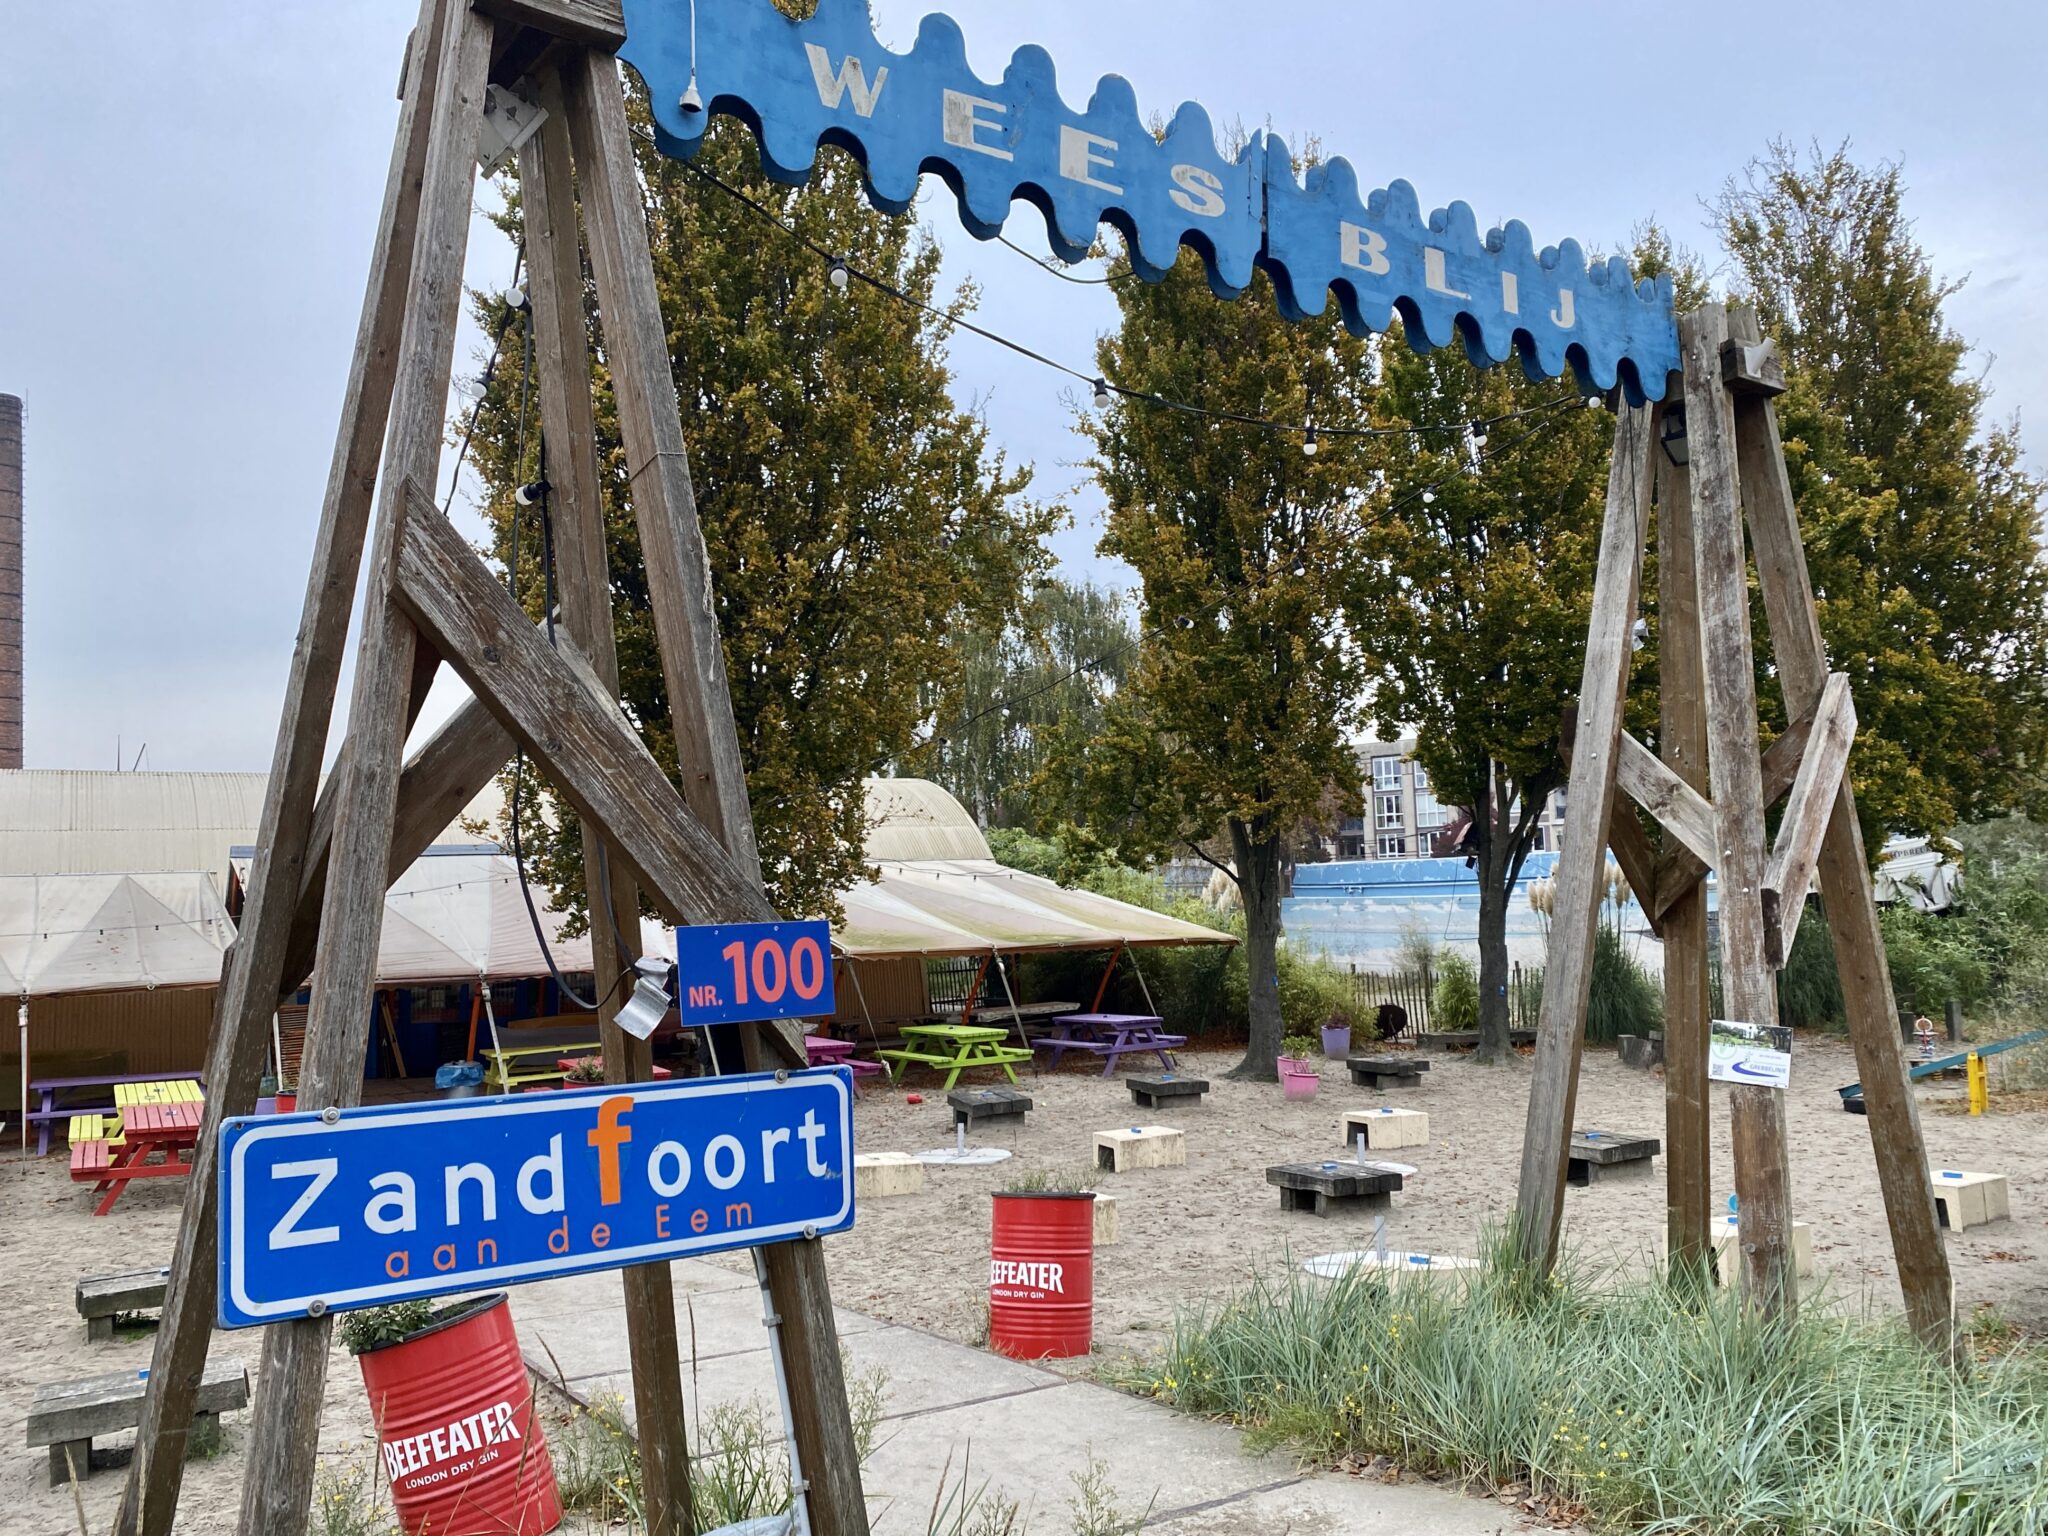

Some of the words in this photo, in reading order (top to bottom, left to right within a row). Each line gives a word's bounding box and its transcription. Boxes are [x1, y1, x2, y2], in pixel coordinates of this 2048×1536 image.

[804, 42, 1226, 217] WEES
[1340, 221, 1576, 329] BLIJ
[688, 985, 723, 1008] NR.
[722, 937, 824, 1005] 100
[269, 1096, 828, 1250] Zandfoort
[385, 1237, 498, 1278] aan
[547, 1216, 611, 1254] de
[656, 1202, 753, 1239] Eem
[991, 1260, 1064, 1294] EEFEATER
[992, 1289, 1012, 1297] LONDON
[1013, 1290, 1028, 1299] DRY
[1030, 1291, 1045, 1299] GIN
[383, 1401, 521, 1483] BEEFEATER
[405, 1470, 448, 1490] LONDON
[450, 1459, 475, 1477] DRY
[478, 1449, 499, 1465] GIN
